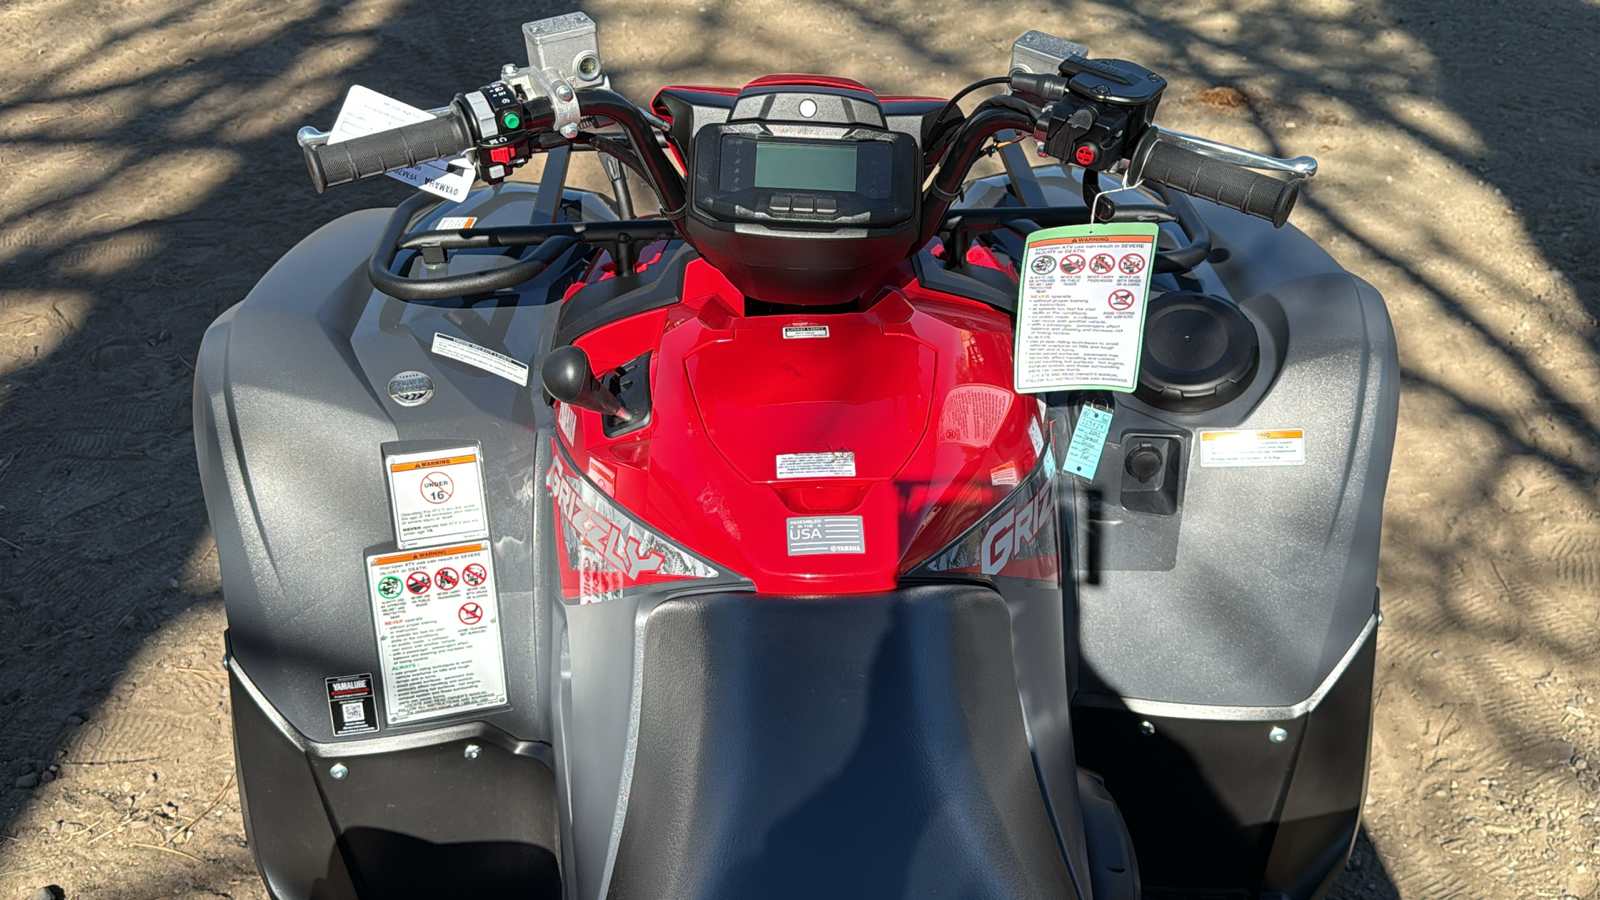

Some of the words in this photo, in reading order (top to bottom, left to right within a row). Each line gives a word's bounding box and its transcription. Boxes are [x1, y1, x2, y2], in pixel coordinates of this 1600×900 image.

[424, 176, 454, 194] YAMAHA
[431, 491, 444, 500] 16
[546, 453, 666, 580] GRIZZLY
[790, 529, 822, 540] USA
[332, 680, 367, 691] YAMALUBE
